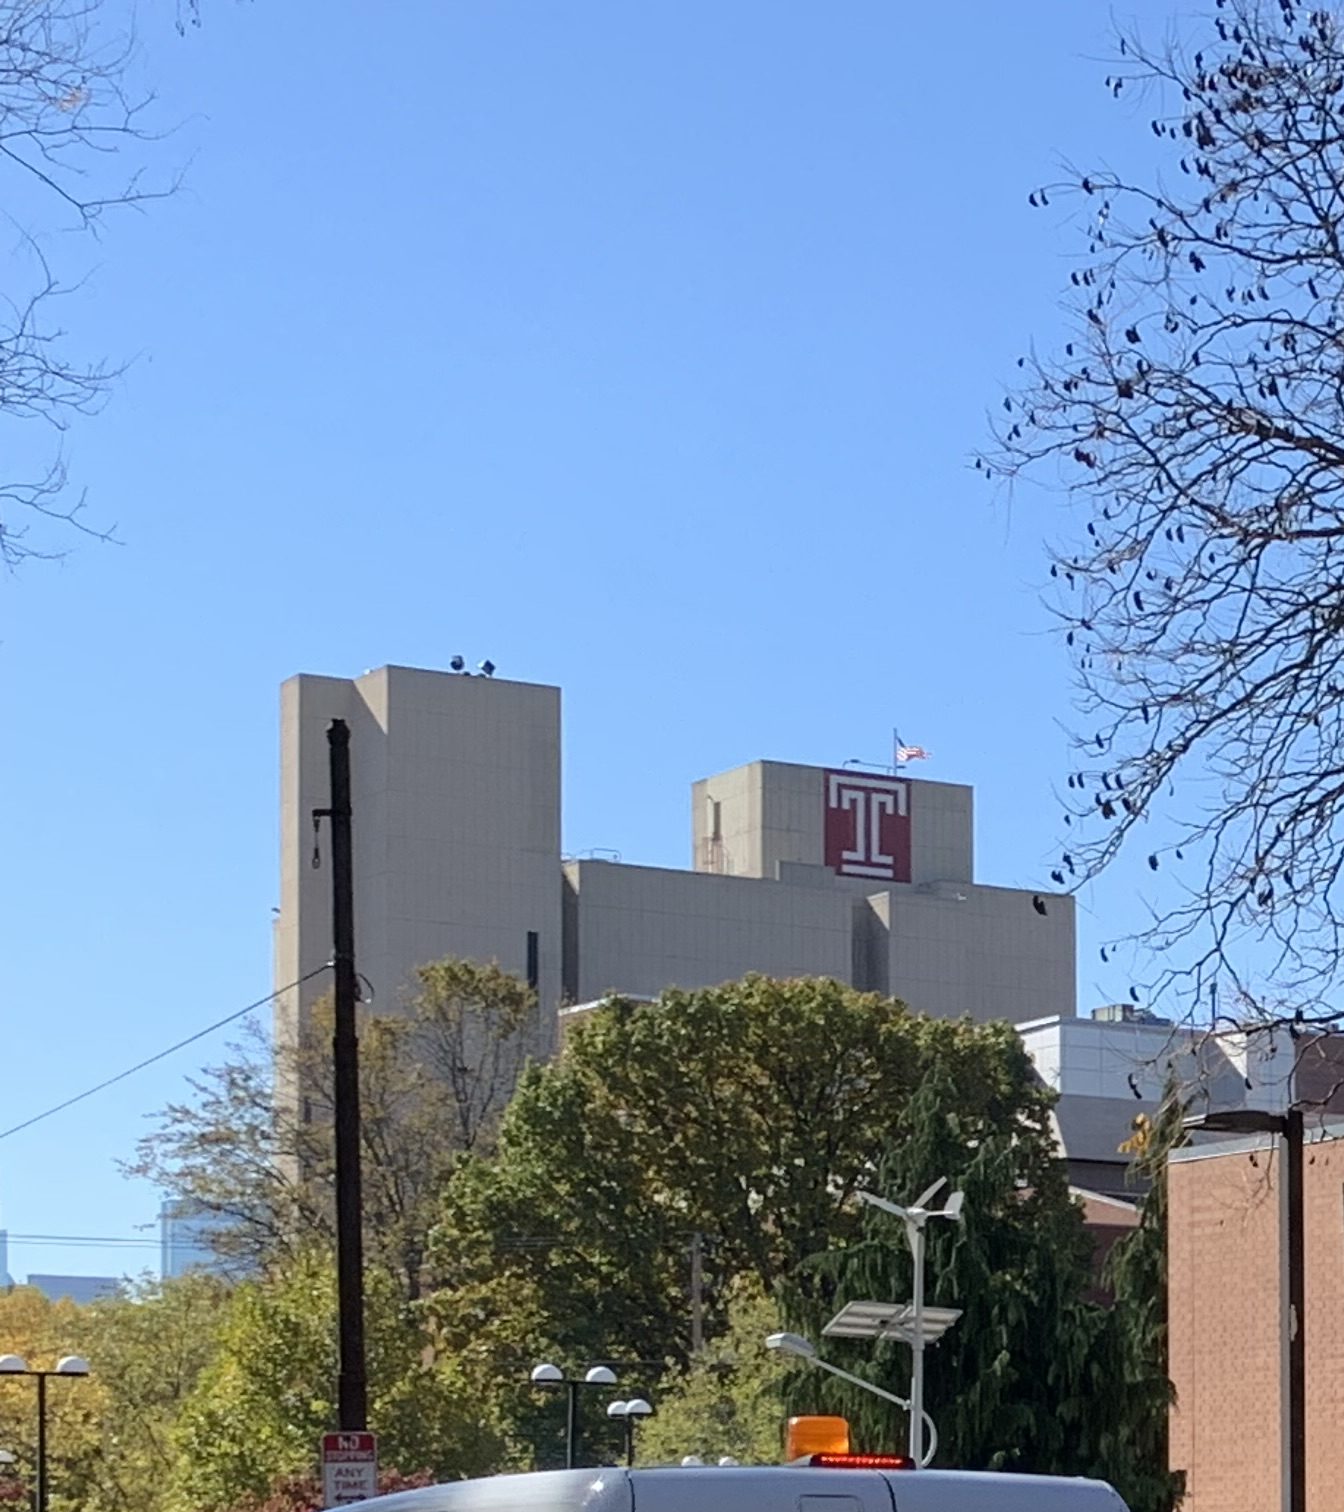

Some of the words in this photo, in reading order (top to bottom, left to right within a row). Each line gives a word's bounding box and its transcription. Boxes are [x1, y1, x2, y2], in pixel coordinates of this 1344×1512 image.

[337, 1435, 360, 1450] NO
[334, 1467, 365, 1478] ANY
[334, 1480, 368, 1491] TIME
